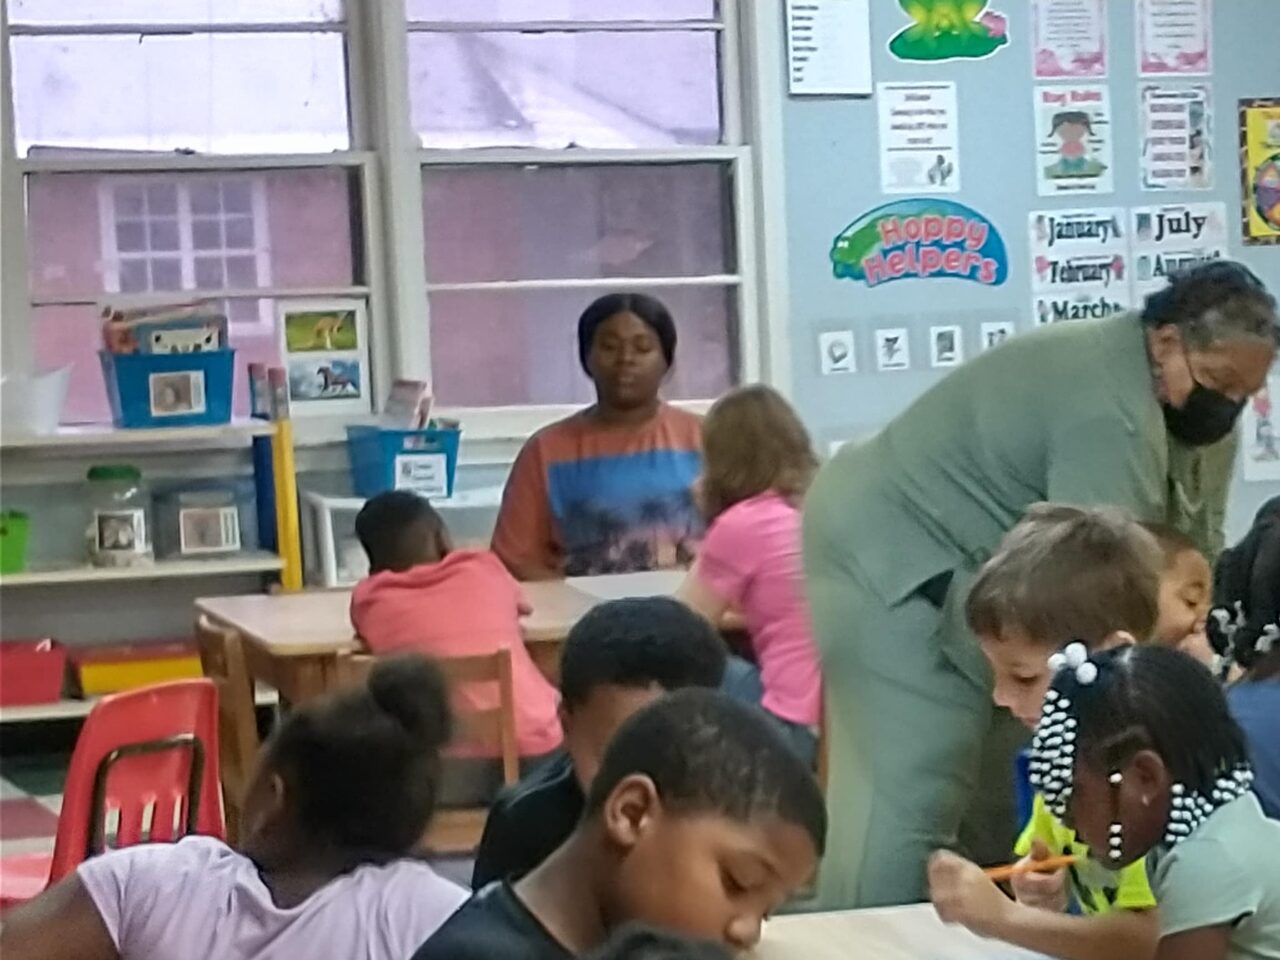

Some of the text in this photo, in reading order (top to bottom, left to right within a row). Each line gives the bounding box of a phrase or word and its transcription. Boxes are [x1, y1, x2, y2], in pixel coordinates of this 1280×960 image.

[879, 215, 989, 249] Hoppy
[1048, 216, 1110, 247] January
[1155, 211, 1207, 241] July
[863, 245, 998, 286] Helpers
[1048, 259, 1111, 287] February
[1052, 297, 1110, 322] March
